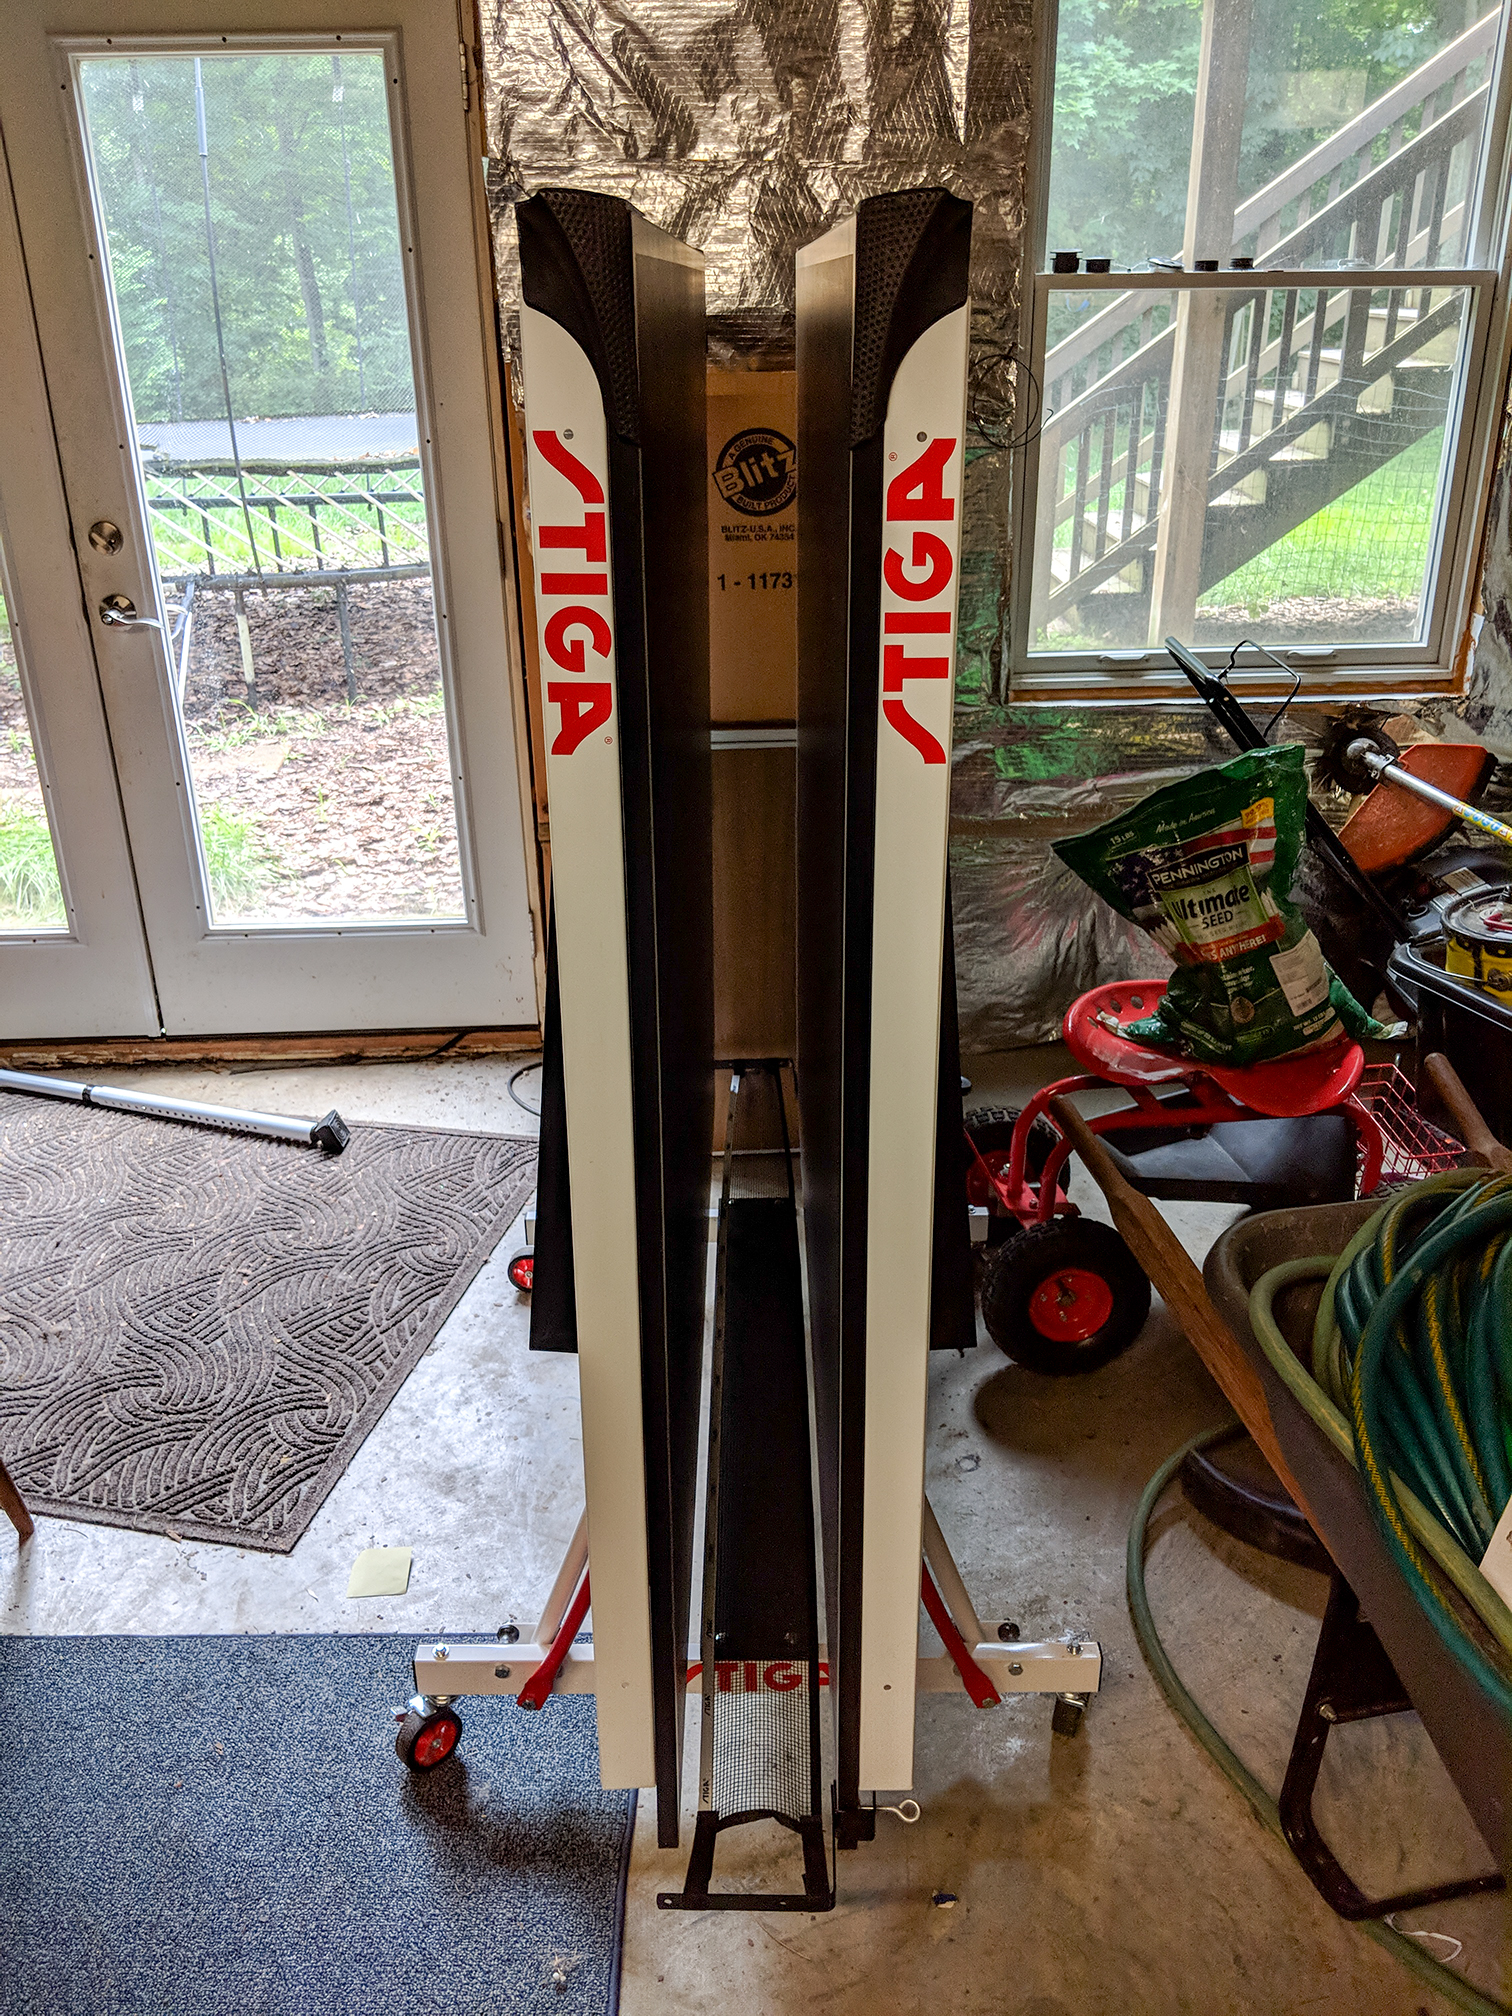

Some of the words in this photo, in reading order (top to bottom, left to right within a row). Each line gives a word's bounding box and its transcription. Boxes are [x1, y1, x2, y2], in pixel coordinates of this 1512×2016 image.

[734, 434, 774, 452] GENUINE
[712, 449, 797, 499] Blitz
[737, 494, 761, 511] BUILT
[764, 474, 796, 510] PRODUCT
[721, 525, 747, 534] BLITZ
[754, 533, 767, 541] OK
[532, 430, 613, 755] STIGA
[717, 573, 726, 590] 1
[748, 571, 796, 589] 1173
[883, 438, 957, 764] STIGA
[1110, 834, 1121, 845] 15
[1155, 820, 1177, 834] Made
[1151, 847, 1244, 885] PENNINGTON
[1171, 885, 1251, 921] Ultimate
[1201, 910, 1234, 930] SEED
[1219, 933, 1267, 959] ANYHERE!
[702, 1778, 710, 1804] STIGA
